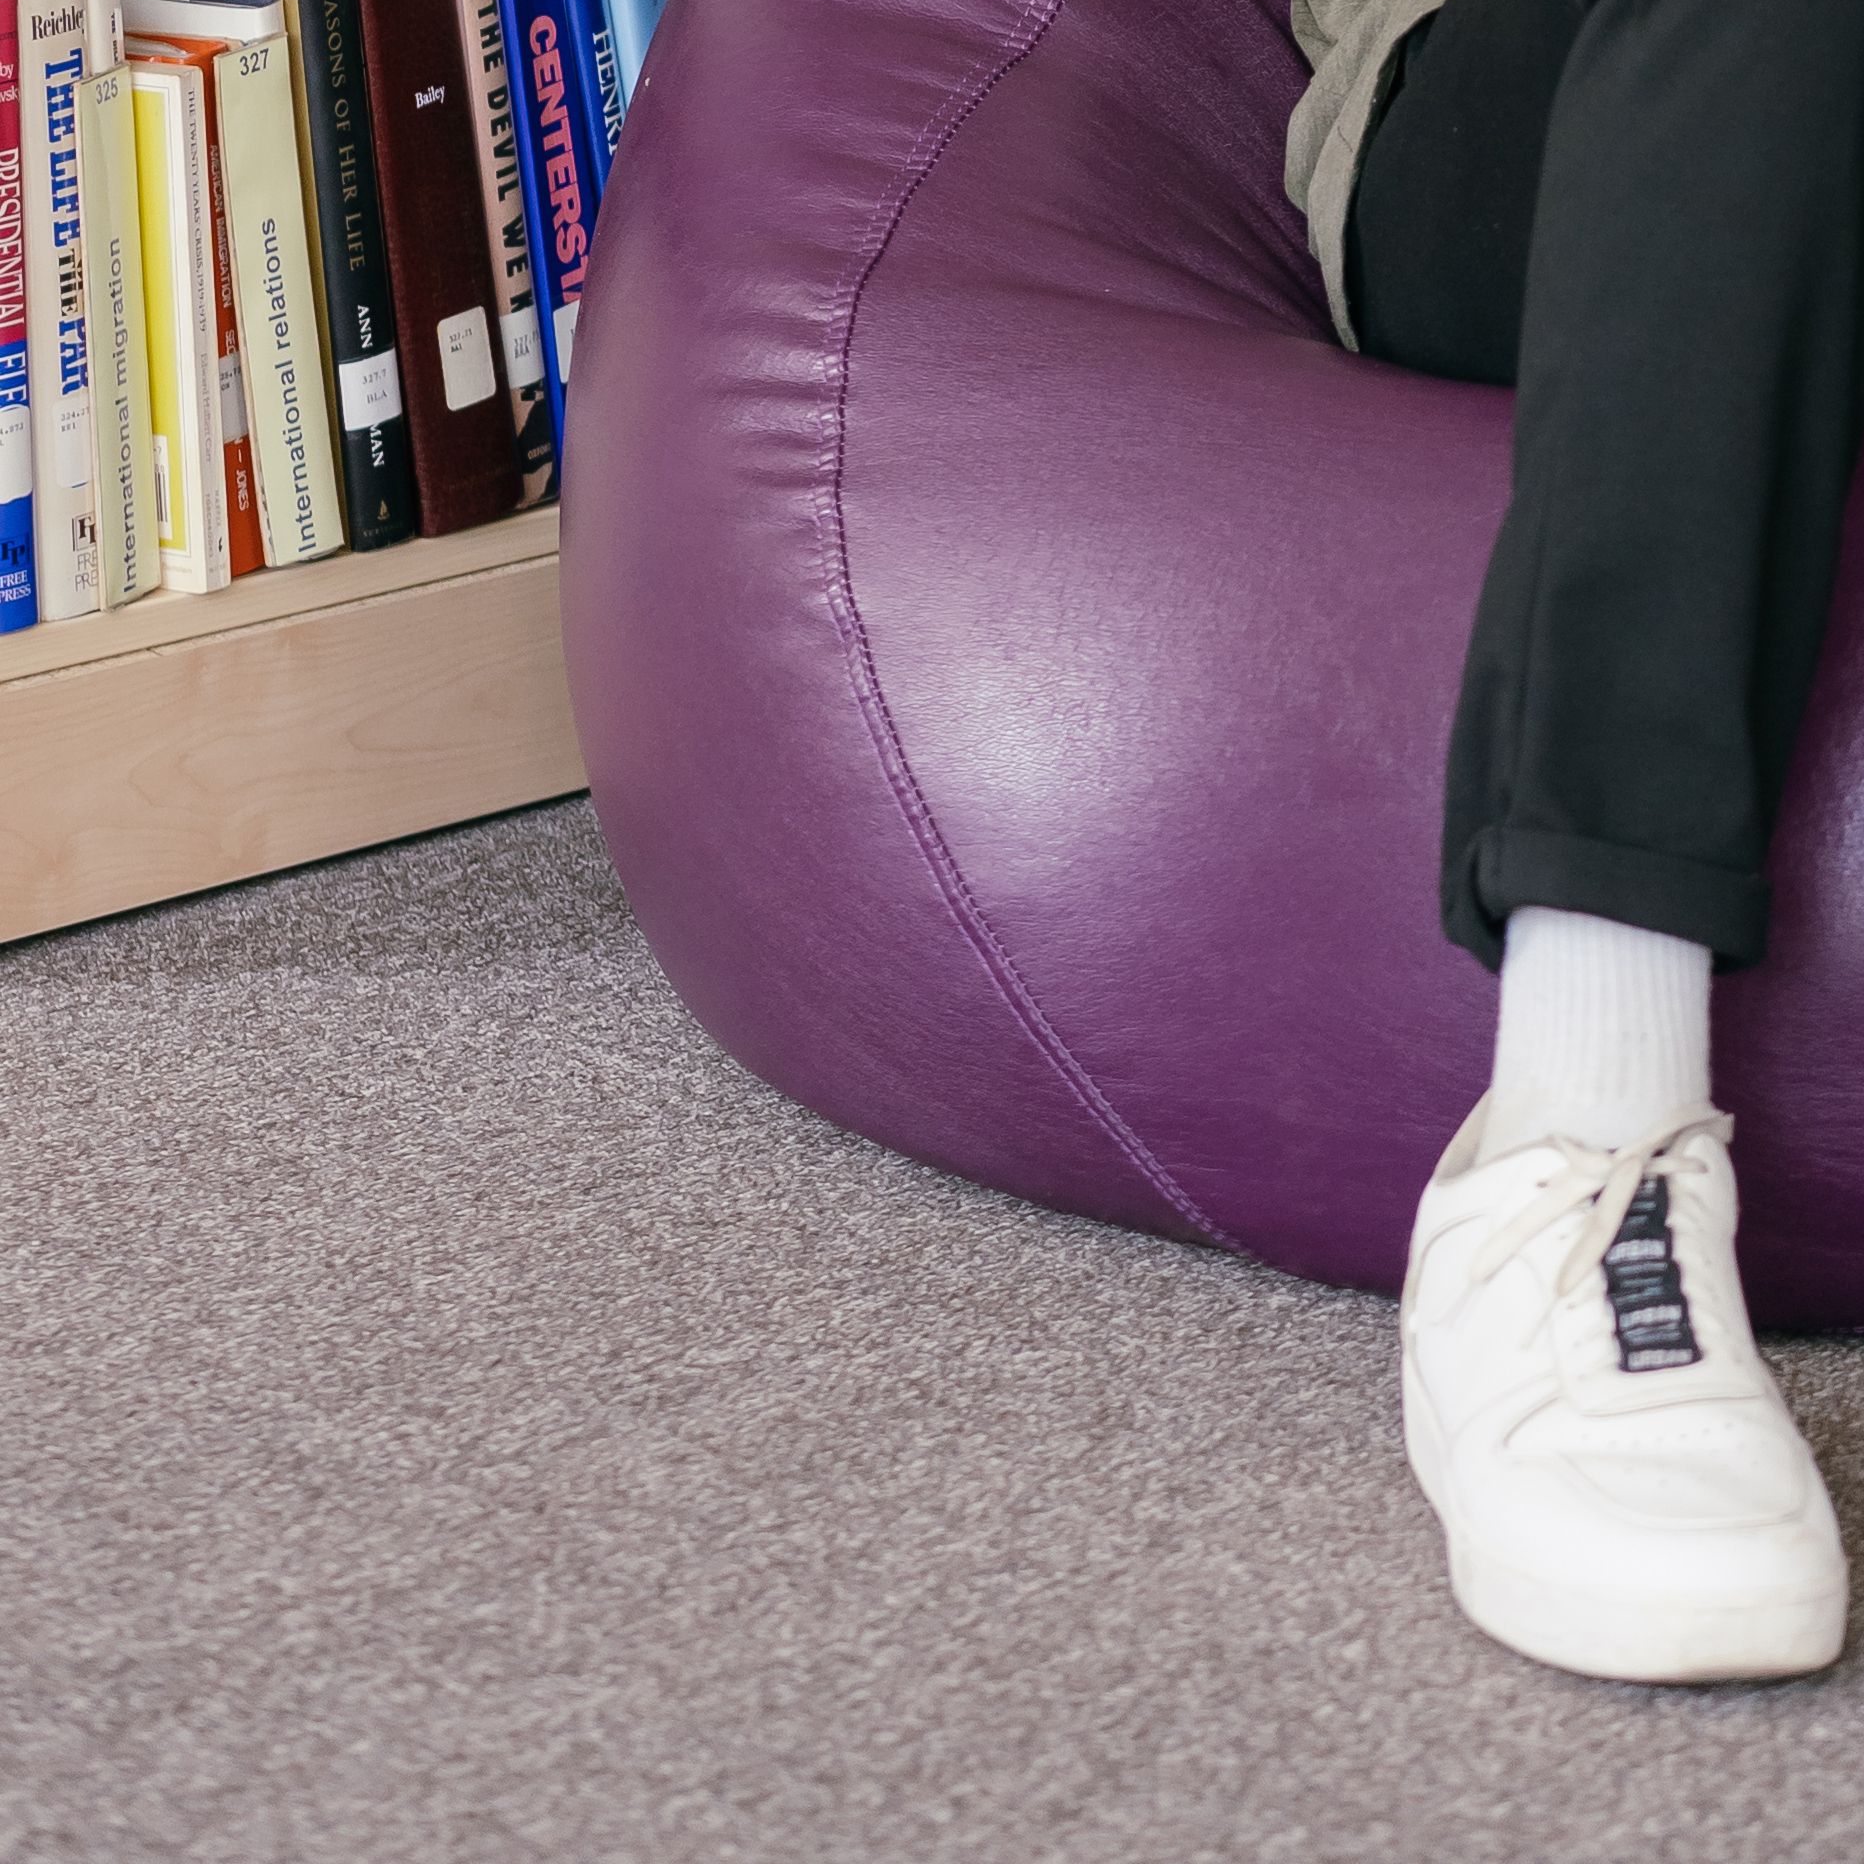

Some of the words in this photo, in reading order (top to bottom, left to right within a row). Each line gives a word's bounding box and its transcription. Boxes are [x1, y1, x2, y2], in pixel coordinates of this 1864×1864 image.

[94, 78, 120, 104] 325
[239, 48, 270, 76] 327
[415, 83, 446, 110] Bailey
[109, 236, 130, 390] migration
[260, 217, 292, 354] relations
[114, 392, 137, 594] International
[279, 360, 314, 554] International
